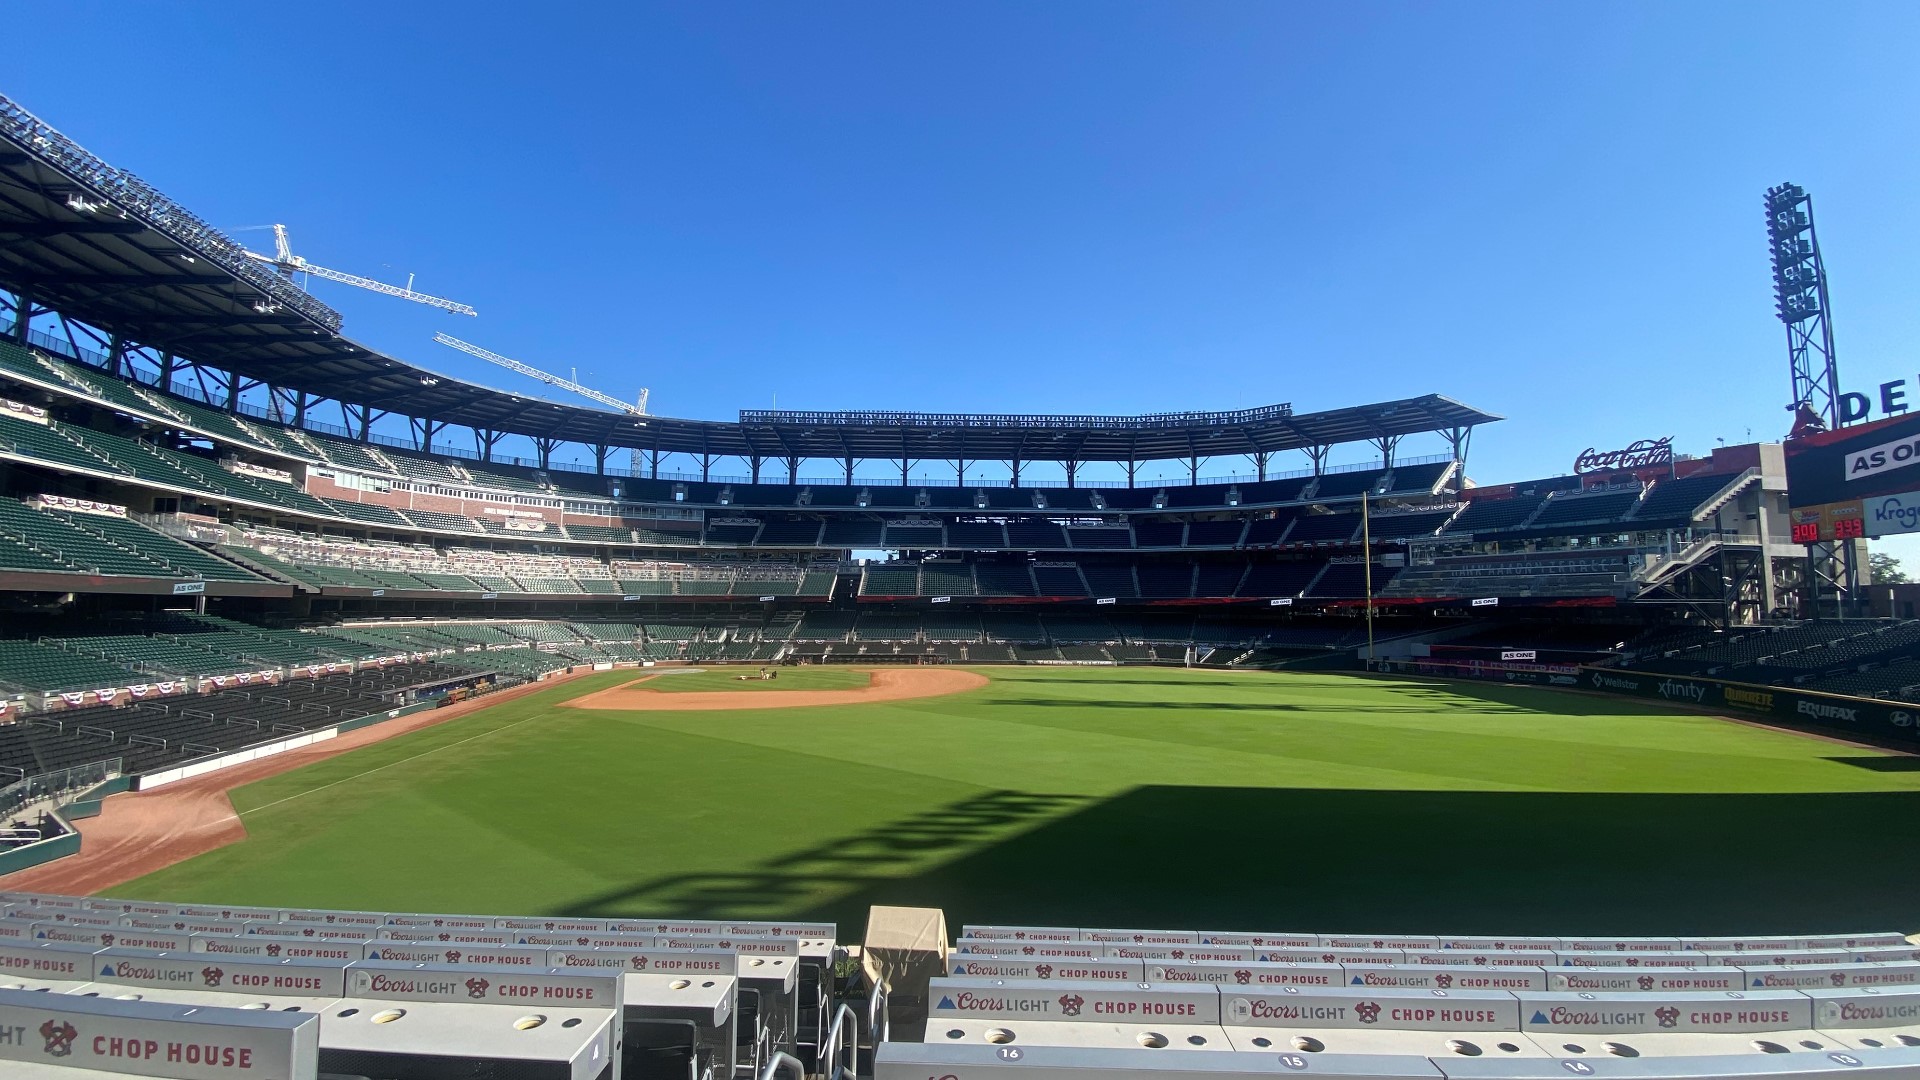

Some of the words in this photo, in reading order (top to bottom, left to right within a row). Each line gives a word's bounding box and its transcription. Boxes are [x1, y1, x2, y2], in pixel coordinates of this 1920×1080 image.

[1839, 375, 1920, 423] DE
[1574, 435, 1674, 474] Coca-Cola
[1852, 451, 1886, 473] AS
[1604, 677, 1638, 690] Wellstar
[1658, 679, 1705, 702] xfinity
[1798, 700, 1857, 721] EQUIFAX
[48, 929, 72, 941] Coors
[72, 934, 96, 943] LIGHT
[120, 938, 143, 947] CHOP
[147, 940, 176, 949] HOUSE
[528, 936, 550, 945] Coors
[616, 940, 642, 948] HOUSE
[206, 941, 234, 953] Coors
[235, 945, 260, 954] LIGHT
[288, 949, 312, 957] CHOP
[316, 950, 348, 959] HOUSE
[382, 948, 411, 960] Coors
[412, 953, 440, 962] LIGHT
[468, 955, 494, 964] CHOP
[498, 956, 531, 965] HOUSE
[971, 945, 994, 954] Coors
[1119, 949, 1142, 958] Coors
[0, 956, 30, 969] CHOP
[34, 960, 74, 972] HOUSE
[566, 954, 596, 966] Coors
[598, 959, 625, 968] LIGHT
[654, 960, 682, 969] CHOP
[686, 961, 720, 969] HOUSE
[116, 961, 156, 980] Coors
[158, 970, 194, 983] LIGHT
[232, 974, 270, 987] CHOP
[274, 977, 320, 990] HOUSE
[967, 963, 998, 975] Coors
[1000, 968, 1029, 976] LIGHT
[1060, 970, 1088, 978] CHOP
[1091, 970, 1128, 979] HOUSE
[1164, 968, 1197, 981] Coors
[1199, 973, 1228, 982] LIGHT
[1259, 975, 1288, 984] CHOP
[1292, 975, 1328, 984] HOUSE
[371, 974, 414, 992] Coors
[417, 982, 456, 995] LIGHT
[499, 985, 538, 998] CHOP
[544, 987, 593, 1000] HOUSE
[1364, 973, 1398, 985] Coors
[1400, 977, 1428, 986] LIGHT
[1460, 979, 1489, 987] CHOP
[1494, 979, 1530, 988] HOUSE
[1568, 976, 1600, 988] Coors
[1602, 980, 1631, 988] LIGHT
[1662, 980, 1690, 988] CHOP
[1694, 980, 1729, 988] HOUSE
[1764, 975, 1795, 986] Coors
[1796, 977, 1824, 986] LIGHT
[1853, 975, 1878, 984] CHOP
[1882, 974, 1914, 982] HOUSE
[958, 992, 1004, 1011] Coors
[1006, 999, 1050, 1012] LIGHT
[1094, 1002, 1136, 1014] CHOP
[1142, 1002, 1196, 1016] HOUSE
[1250, 1000, 1299, 1019] Coors
[1302, 1007, 1345, 1020] LIGHT
[1392, 1009, 1435, 1022] CHOP
[1442, 1010, 1496, 1023] HOUSE
[1841, 1002, 1884, 1020] Coors
[1886, 1005, 1920, 1018] LIGH
[1551, 1007, 1599, 1026] Coors
[1600, 1012, 1645, 1025] LIGHT
[1691, 1011, 1733, 1024] CHOP
[1738, 1011, 1790, 1023] HOUSE
[93, 1036, 159, 1060] CHOP
[167, 1042, 253, 1068] HOUSE
[1002, 1049, 1018, 1058] 16
[1832, 1055, 1857, 1064] 13
[1283, 1056, 1303, 1066] 15
[1566, 1062, 1589, 1072] 14
